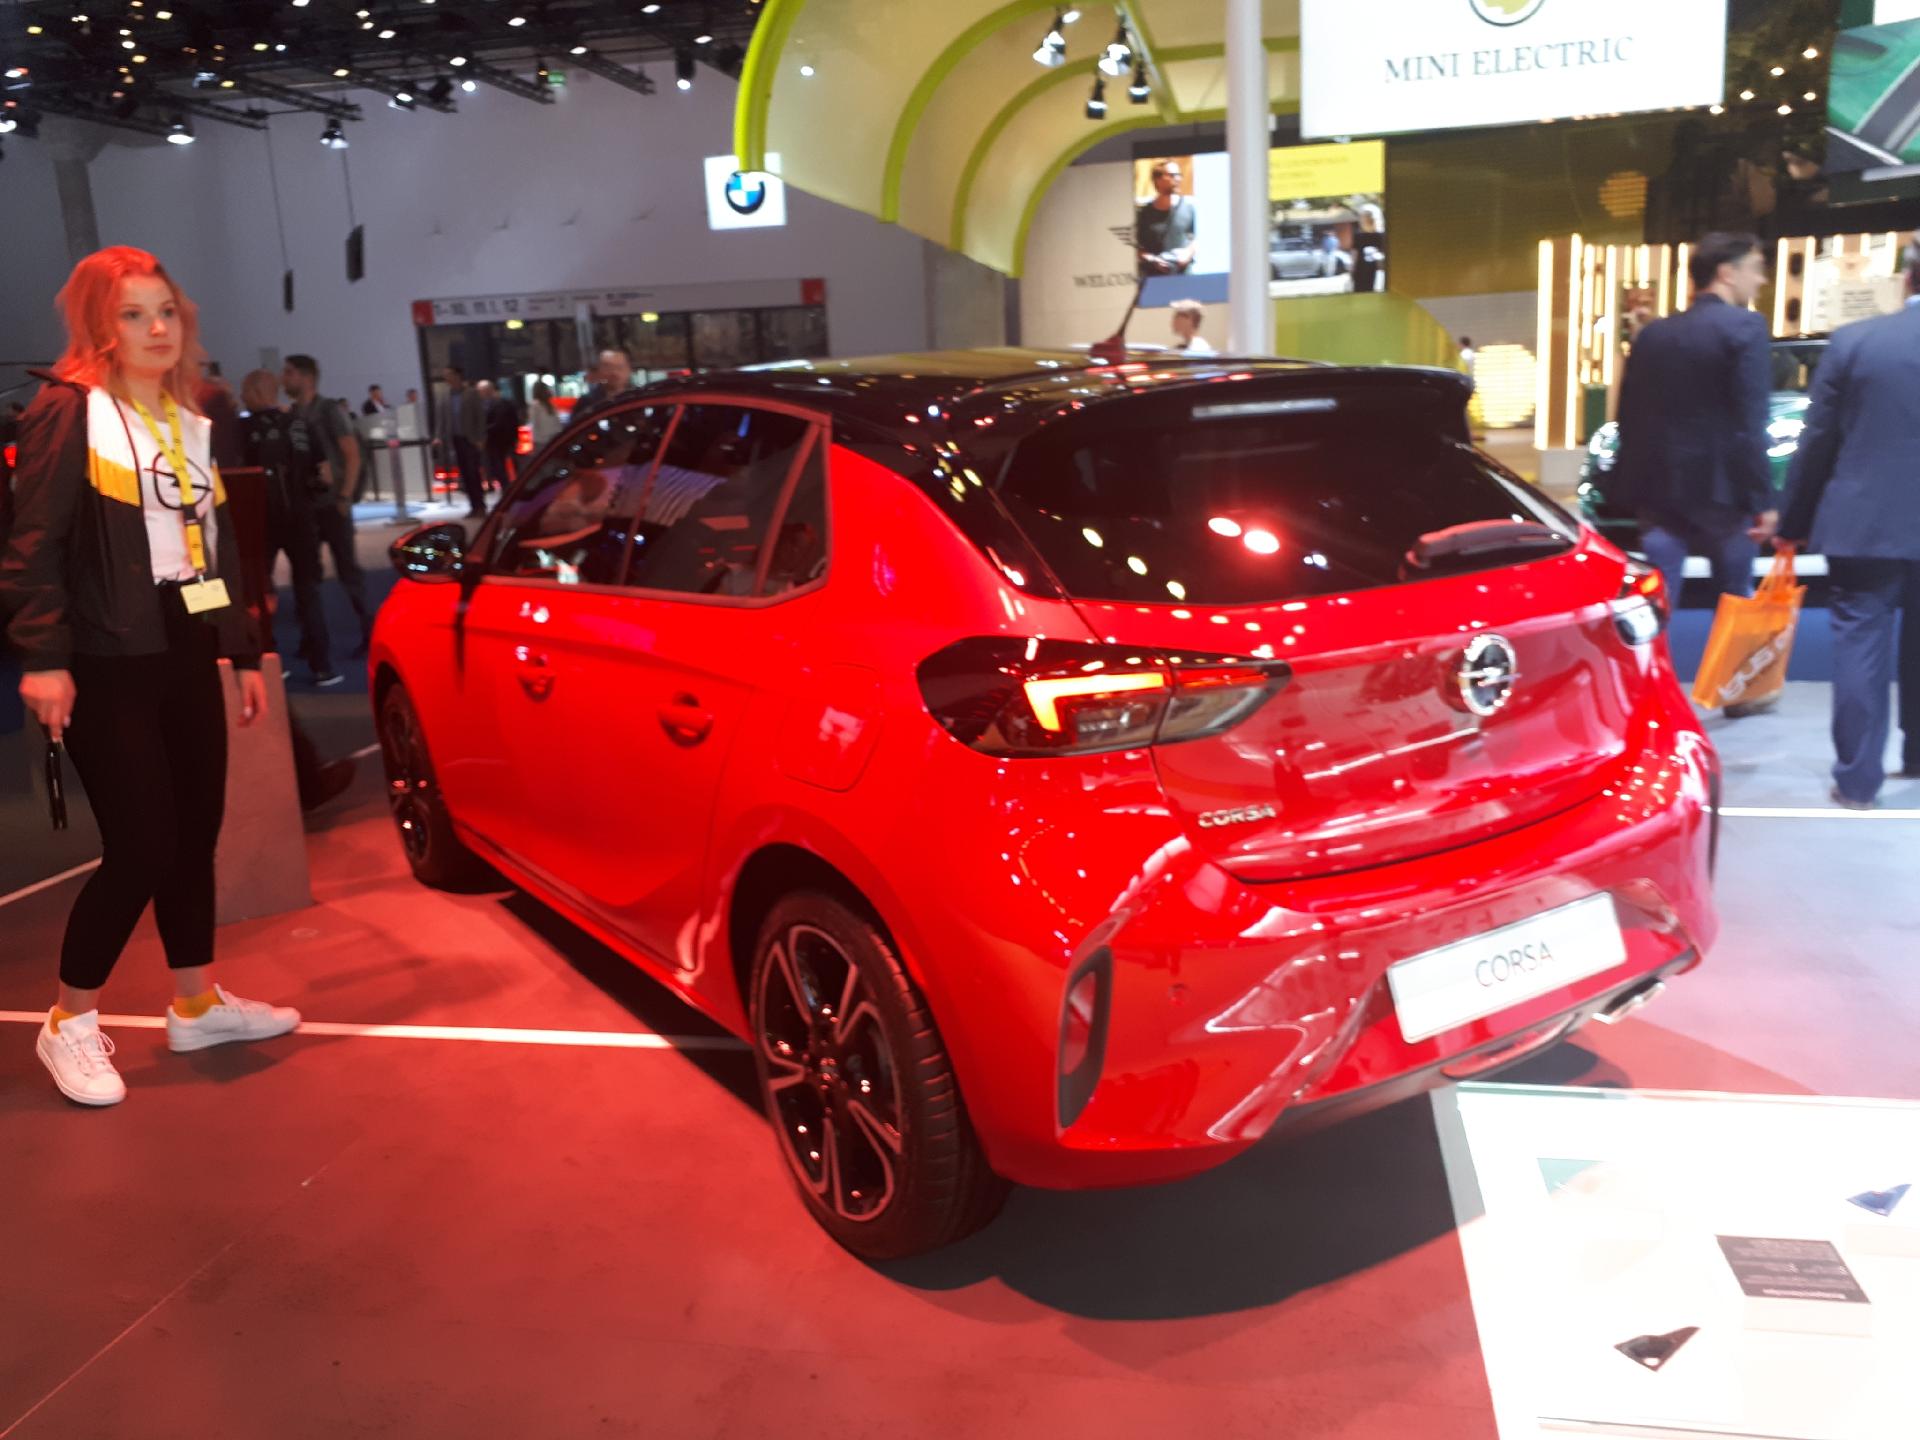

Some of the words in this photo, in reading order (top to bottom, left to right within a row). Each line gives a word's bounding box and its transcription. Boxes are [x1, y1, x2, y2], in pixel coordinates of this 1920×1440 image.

[1384, 52, 1462, 83] MINI
[1472, 36, 1634, 76] ELECTRIC
[1198, 803, 1277, 829] CORSA
[1475, 941, 1555, 988] CORSA
